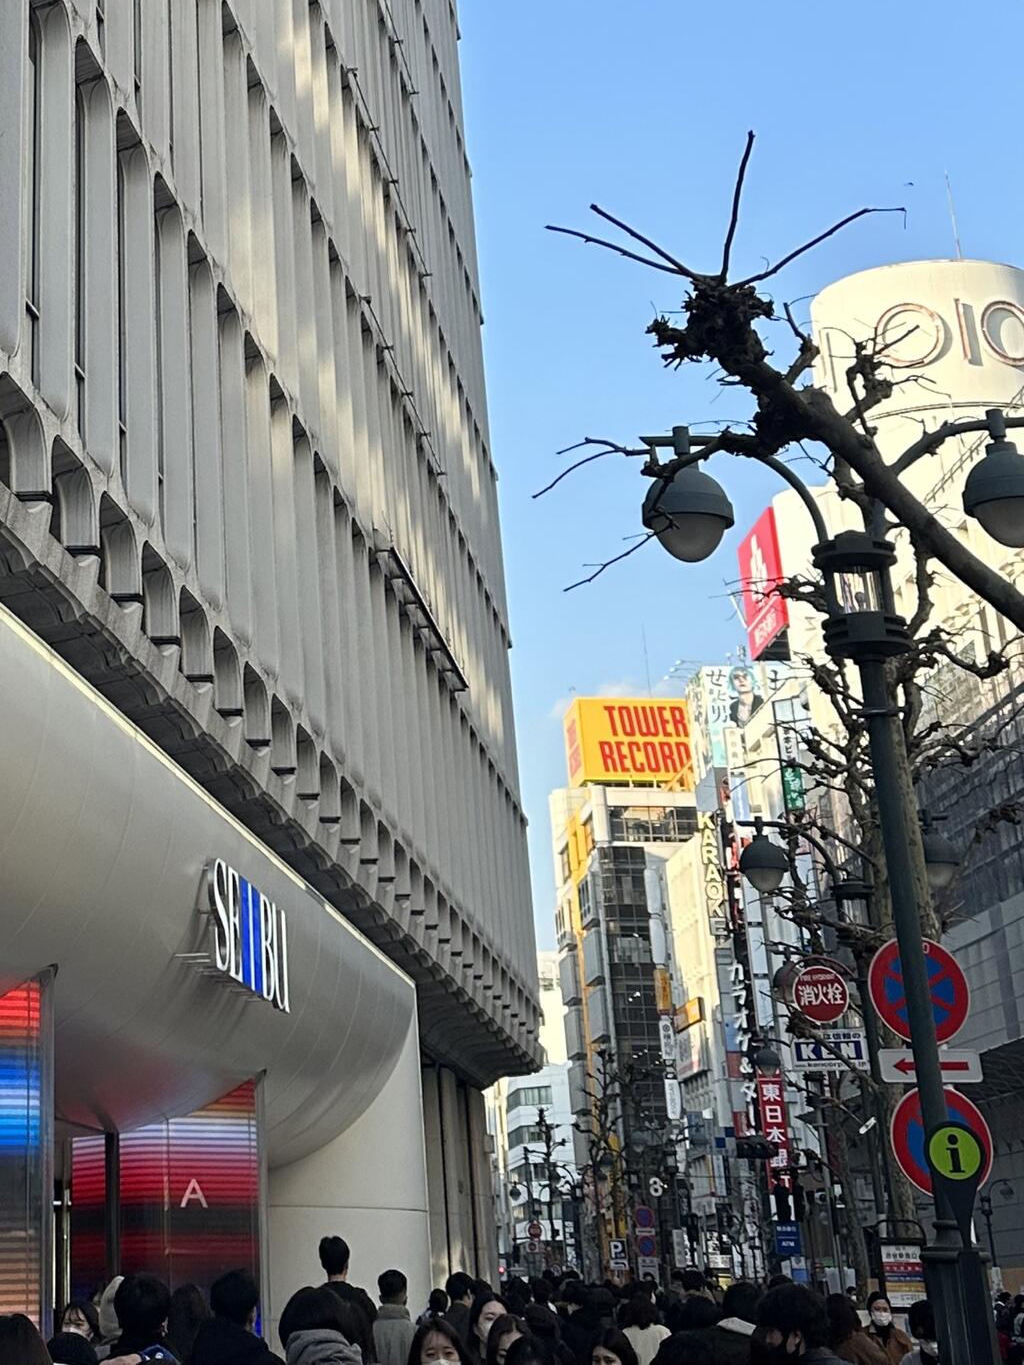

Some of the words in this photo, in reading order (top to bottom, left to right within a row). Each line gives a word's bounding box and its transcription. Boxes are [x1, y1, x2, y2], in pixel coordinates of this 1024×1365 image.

[603, 705, 689, 737] TOWER
[697, 811, 728, 935] KARAOKE
[214, 858, 290, 1013] SEIBU
[797, 983, 845, 1006] 消火栓
[610, 1241, 623, 1259] P
